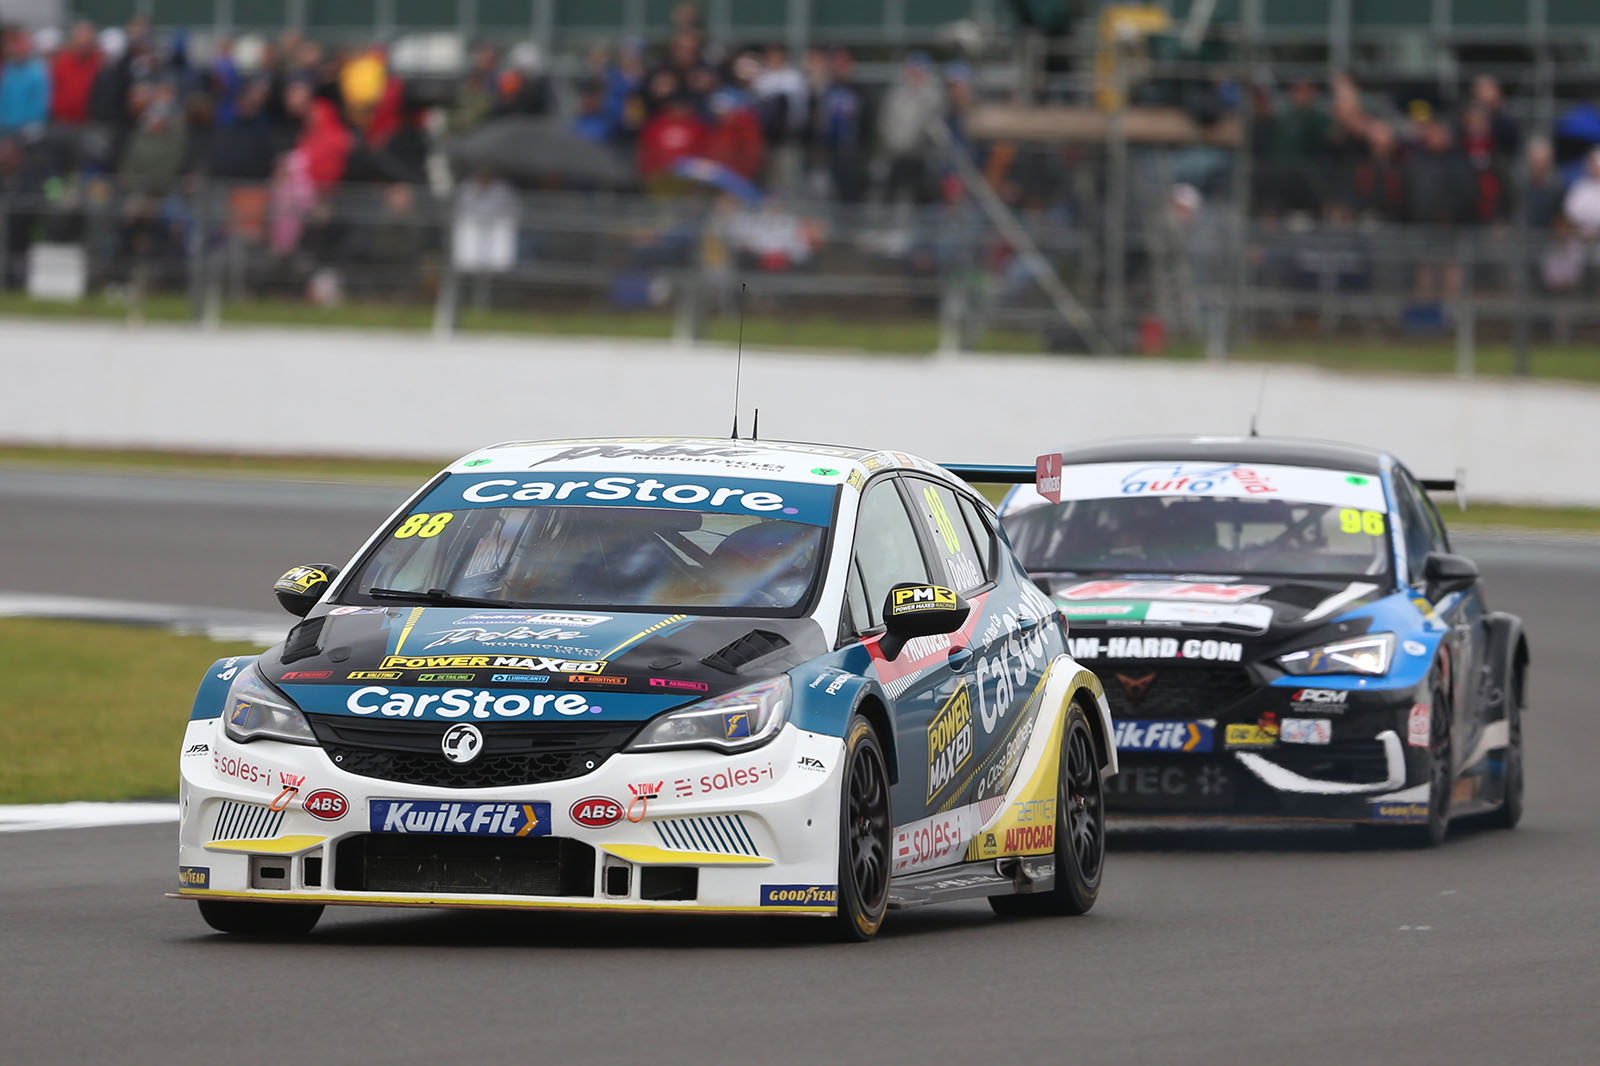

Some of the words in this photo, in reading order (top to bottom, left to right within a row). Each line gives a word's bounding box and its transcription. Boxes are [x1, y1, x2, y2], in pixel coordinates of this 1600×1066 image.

[633, 456, 787, 470] MOTORCYCLES
[1121, 476, 1214, 494] auto
[394, 512, 454, 539] 88
[1339, 508, 1385, 536] 96
[895, 587, 954, 605] PMR
[386, 656, 490, 668] POWER
[492, 656, 602, 673] MAXED
[930, 688, 971, 762] POWER
[186, 743, 210, 754] JFA
[797, 756, 825, 769] JFA
[929, 723, 972, 796] MAXED
[221, 756, 273, 787] sales-i
[284, 773, 299, 786] TOW
[700, 762, 775, 794] sales-i
[637, 782, 655, 795] TOW
[310, 797, 344, 813] ABS
[578, 804, 620, 819] ABS
[911, 815, 962, 865] sales-i
[1003, 824, 1054, 853] AUTOCAR
